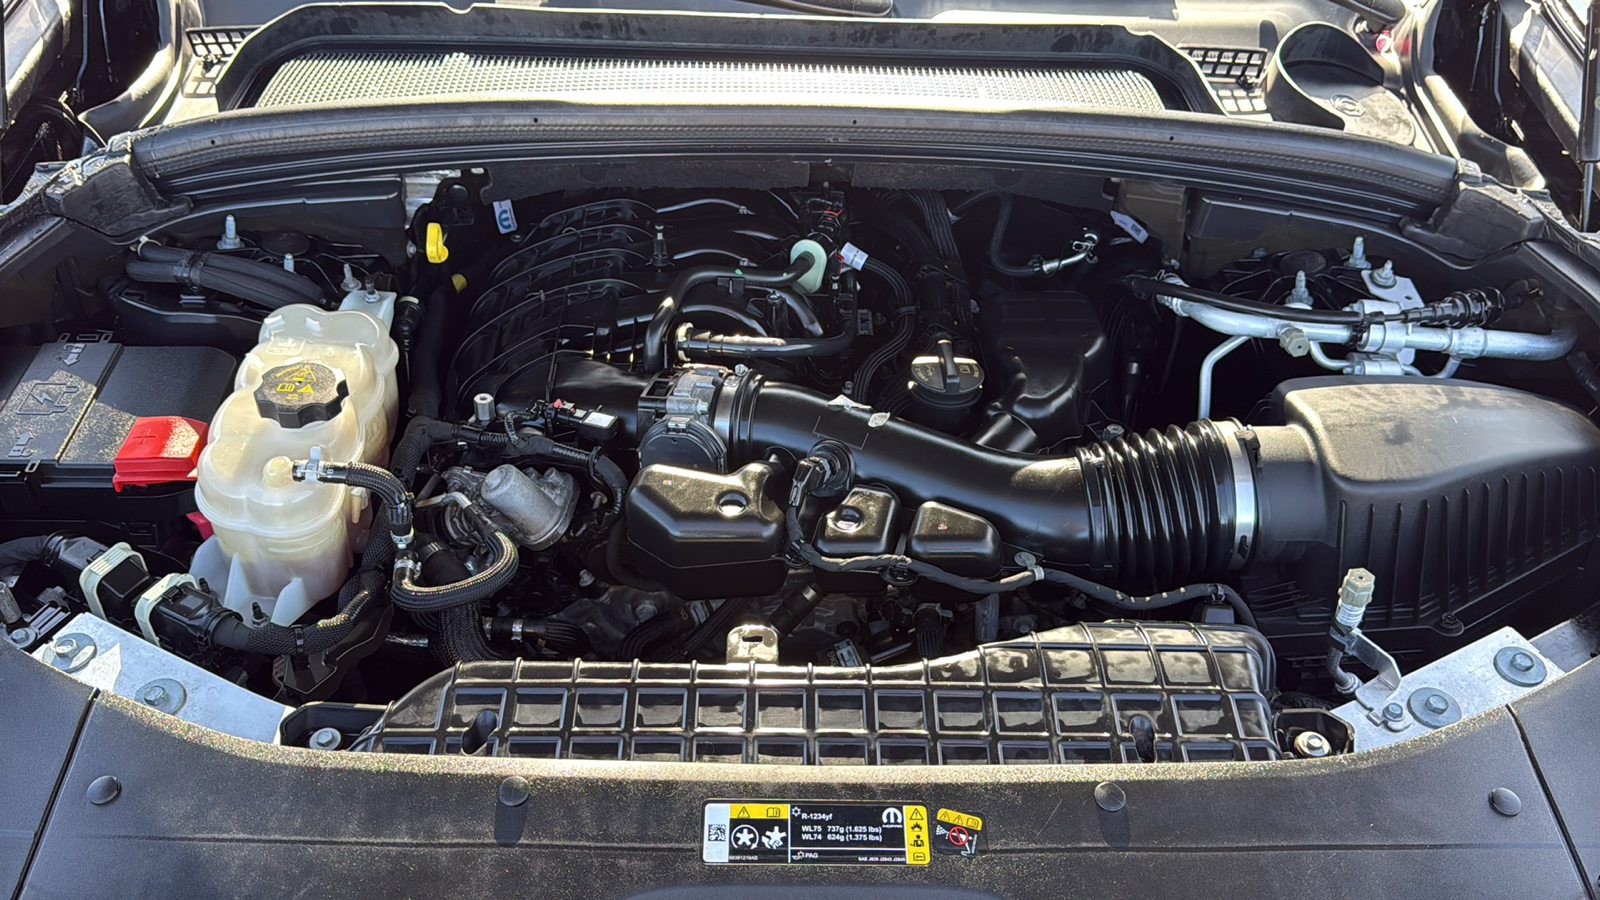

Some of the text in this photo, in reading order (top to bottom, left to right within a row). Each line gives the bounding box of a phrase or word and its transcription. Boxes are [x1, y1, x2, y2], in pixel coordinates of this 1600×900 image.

[801, 813, 833, 821] R-1234yf
[827, 825, 844, 834] 737g
[845, 825, 868, 834] (1.625
[869, 825, 882, 834] lbs)
[827, 834, 844, 843] 624g
[845, 834, 868, 843] (1.375
[869, 834, 883, 843] lbs)
